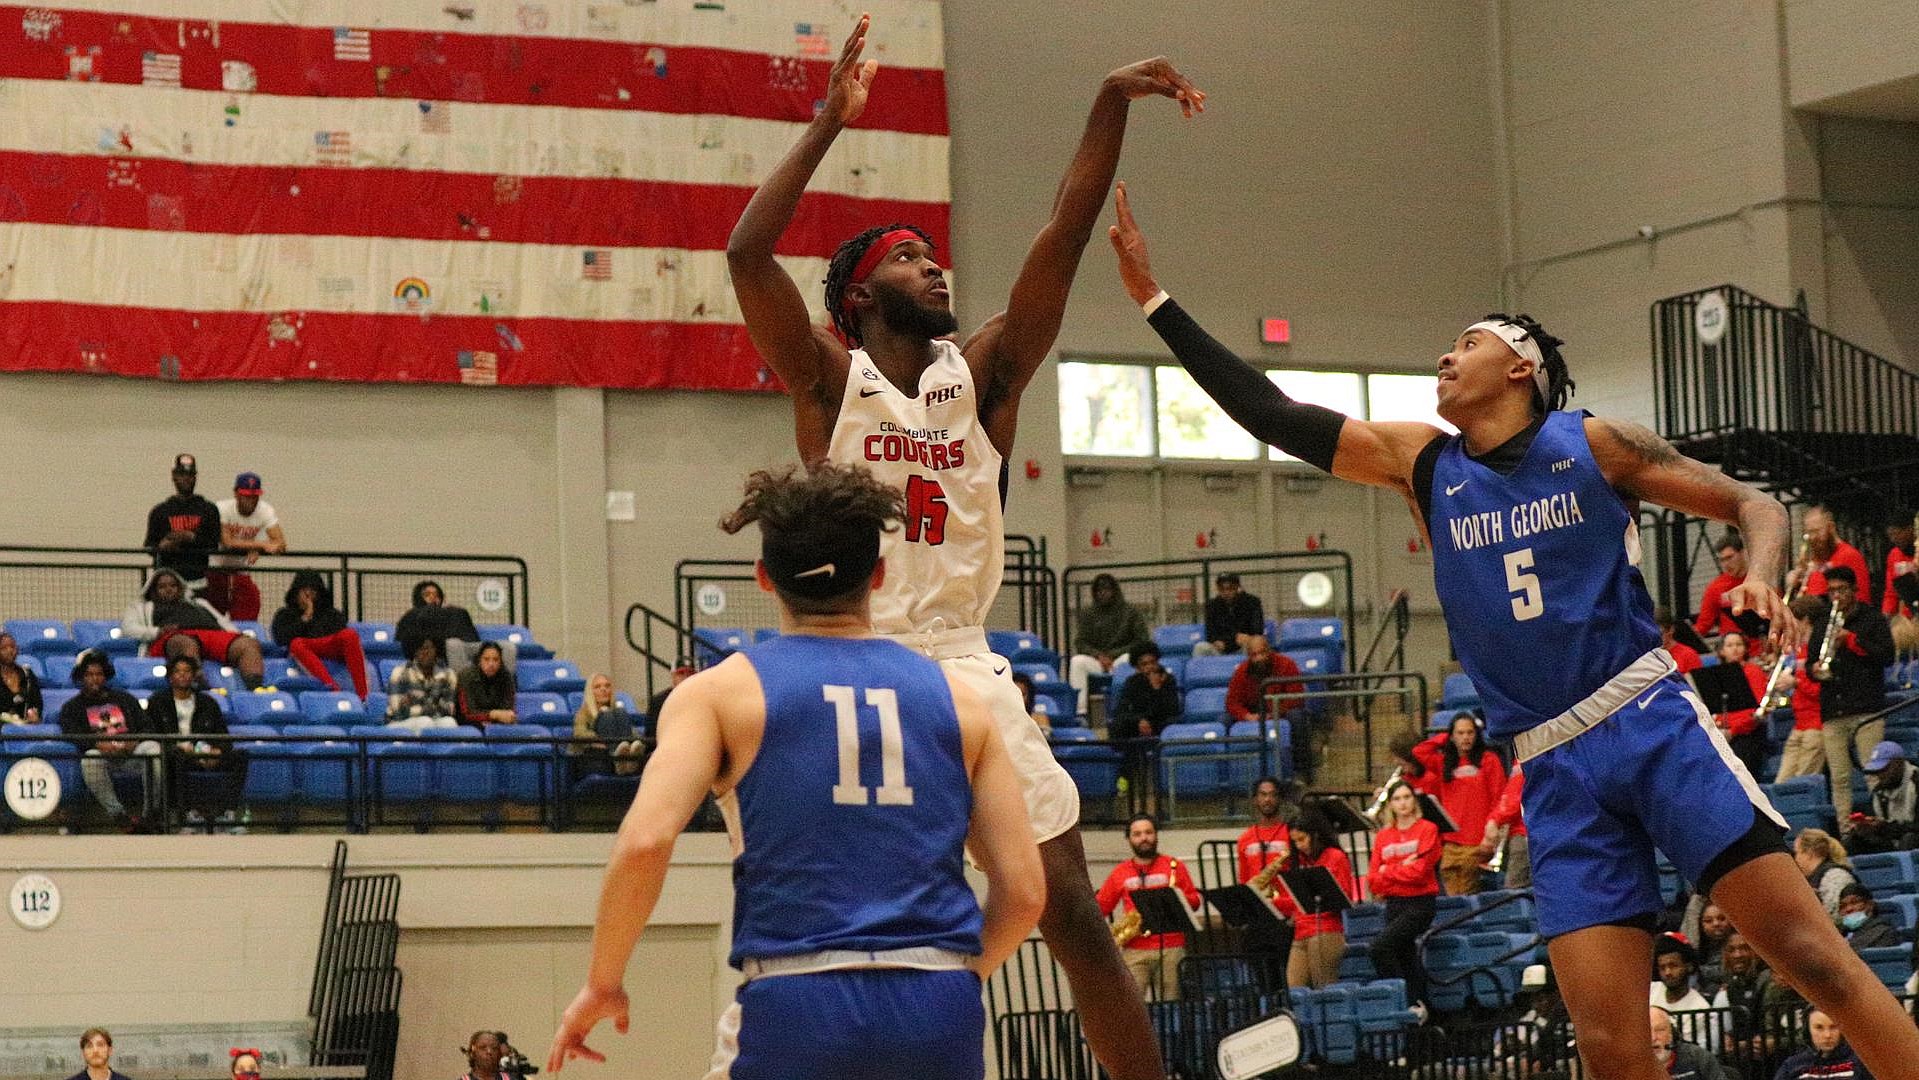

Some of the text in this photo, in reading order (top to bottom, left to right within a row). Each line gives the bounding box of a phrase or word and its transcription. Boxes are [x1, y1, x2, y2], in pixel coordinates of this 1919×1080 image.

[925, 384, 963, 407] PBC
[864, 434, 965, 471] COUGRS
[905, 474, 949, 546] 15
[1449, 490, 1584, 552] NORTH GEORGIA
[1502, 547, 1544, 622] 5
[822, 684, 914, 805] 11
[18, 777, 47, 799] 112
[21, 890, 50, 912] 112
